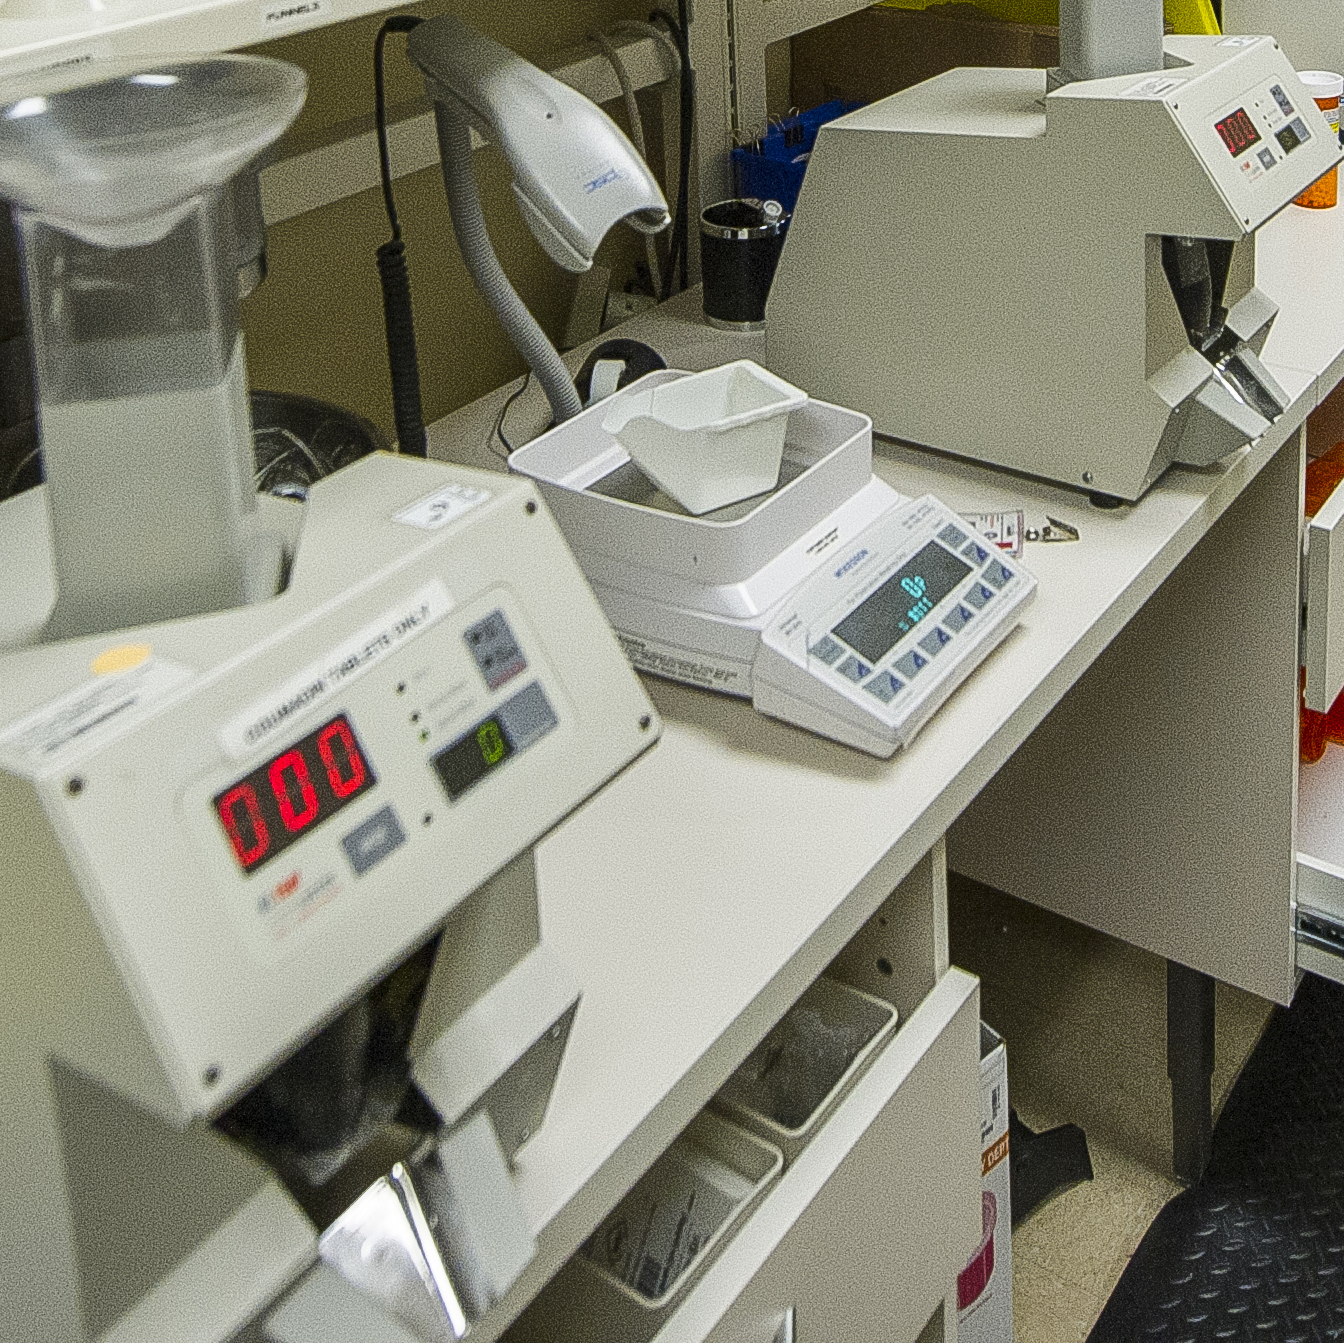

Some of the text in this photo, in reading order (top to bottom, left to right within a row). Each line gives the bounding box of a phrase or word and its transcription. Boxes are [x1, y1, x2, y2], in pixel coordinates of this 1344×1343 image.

[266, 0, 321, 21] FUNNELS
[477, 718, 505, 766] 0
[217, 716, 366, 868] 000
